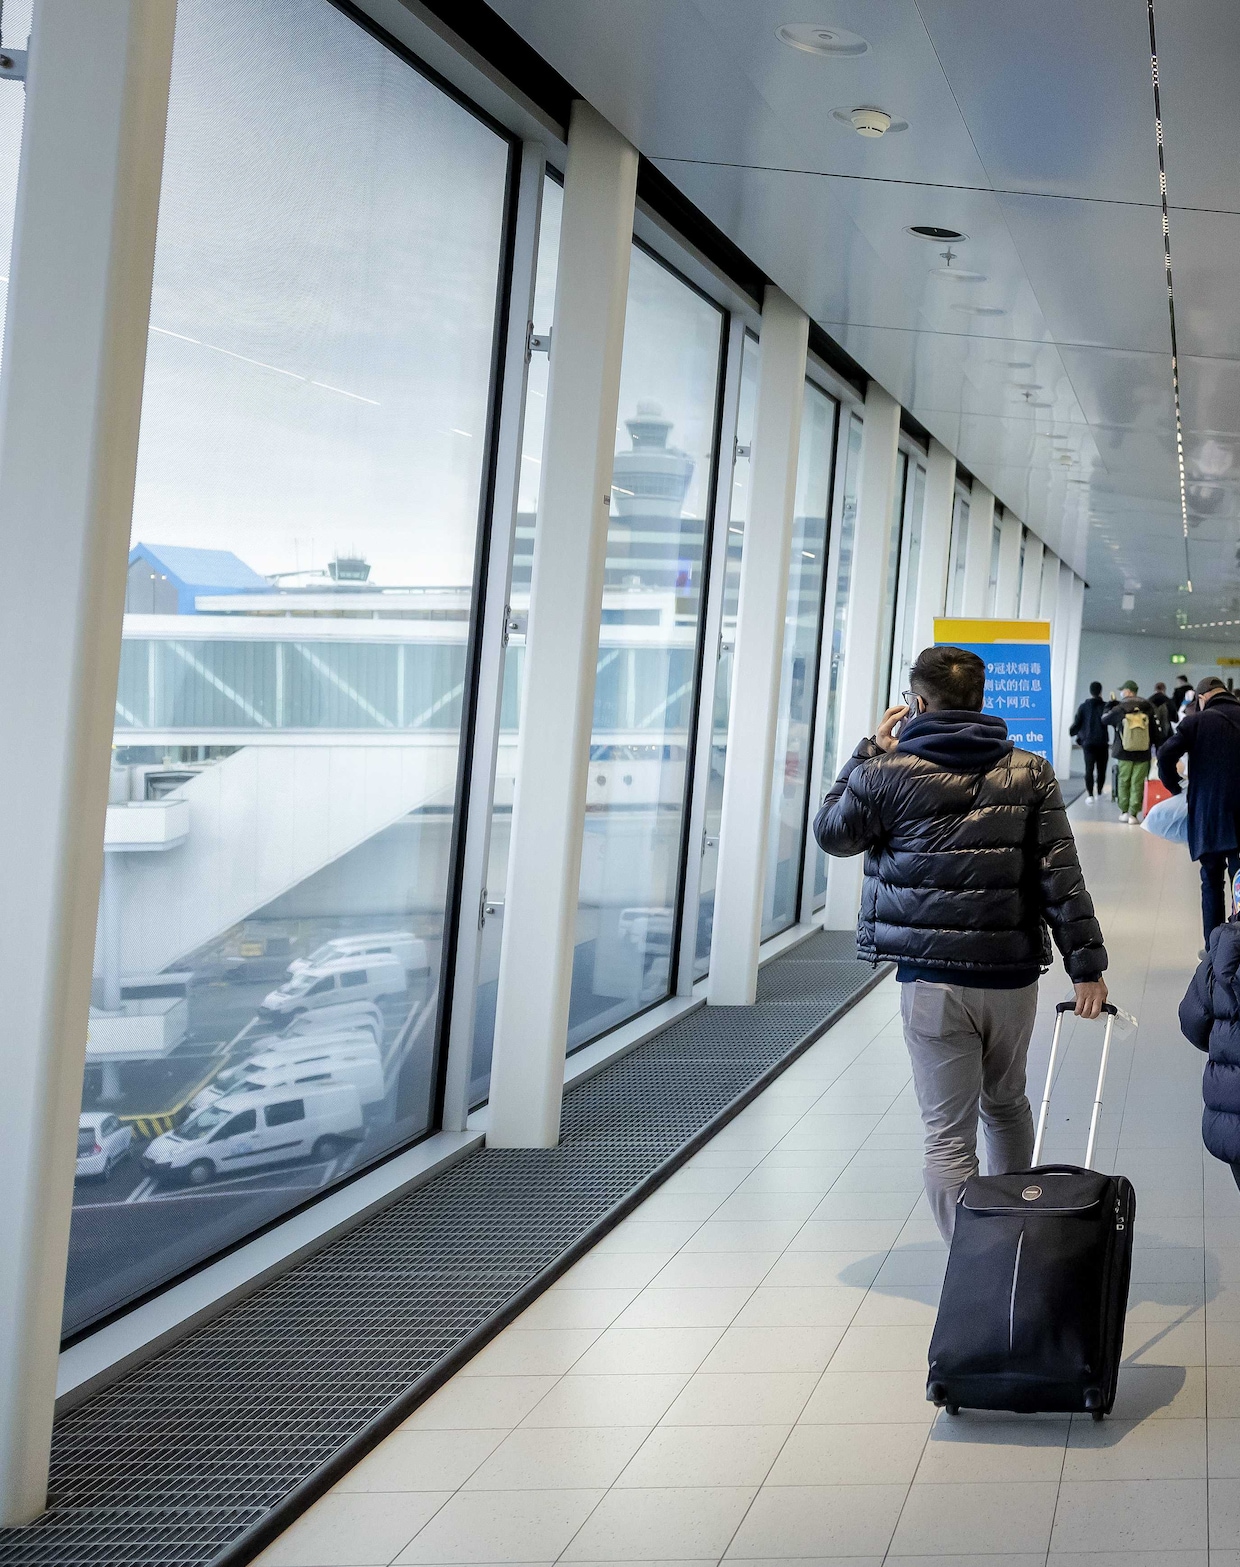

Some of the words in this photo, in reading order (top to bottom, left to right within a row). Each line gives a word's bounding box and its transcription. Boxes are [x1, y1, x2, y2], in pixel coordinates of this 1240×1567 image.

[987, 662, 1041, 675] 9冠状病毒
[984, 695, 1036, 709] 这个网页。
[1008, 733, 1023, 742] on
[1026, 730, 1044, 742] the
